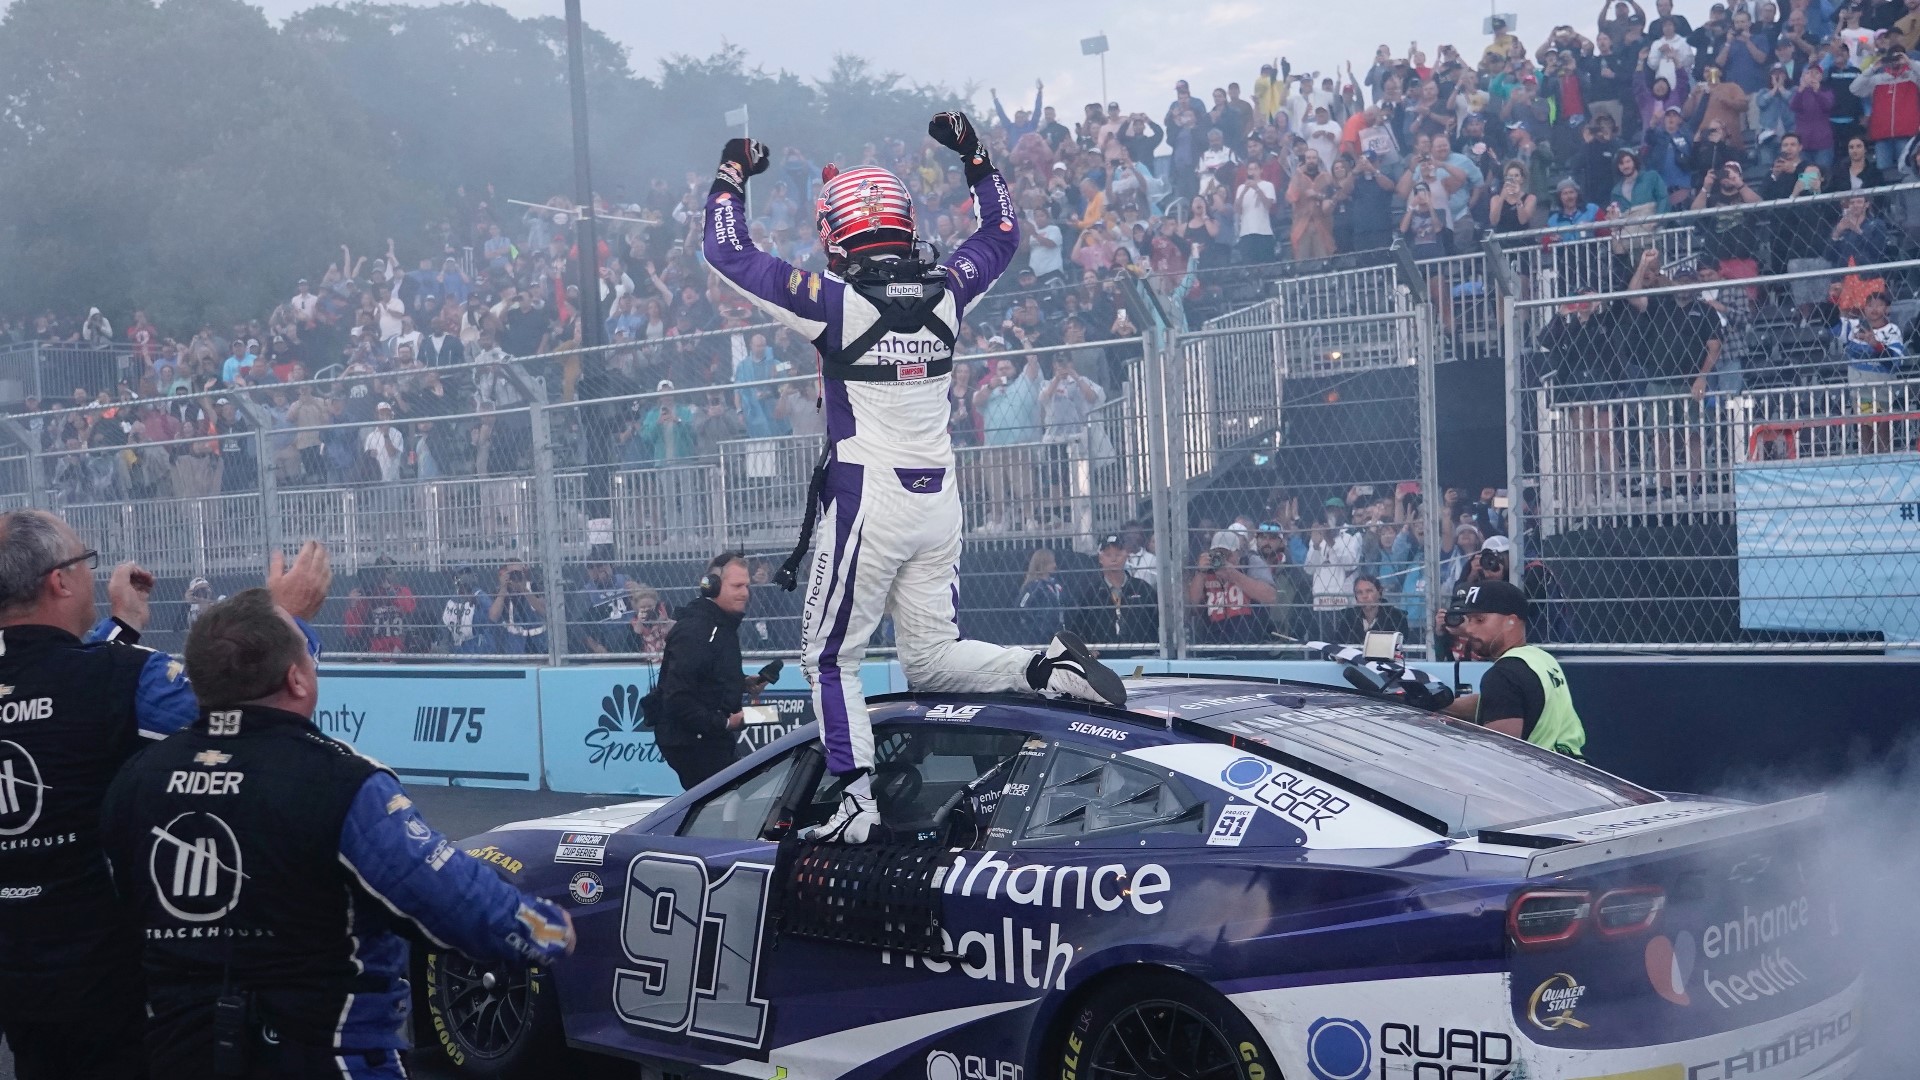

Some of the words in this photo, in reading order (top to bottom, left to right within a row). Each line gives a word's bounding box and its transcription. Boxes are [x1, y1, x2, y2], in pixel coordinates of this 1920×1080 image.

[714, 206, 727, 244] health
[725, 205, 743, 251] enhance
[890, 286, 919, 295] Hybrid
[866, 335, 950, 353] nhanc
[901, 367, 924, 376] SIMPSON
[807, 552, 829, 607] health
[1067, 721, 1129, 741] SIEMENS
[584, 728, 667, 771] Sports
[166, 770, 244, 794] RIDER
[1270, 771, 1350, 815] QUAD
[1254, 783, 1335, 832] LOCK
[575, 834, 603, 844] NASCAR
[1214, 815, 1248, 837] 91
[562, 847, 577, 857] CUP
[577, 848, 598, 858] SERIES
[0, 885, 43, 899] sparco
[944, 850, 1171, 915] nhance
[1702, 895, 1809, 959] enhance
[613, 851, 775, 1049] 91
[1541, 985, 1586, 1002] QUAKER
[1703, 947, 1808, 1009] health
[1546, 997, 1579, 1012] STATE
[1380, 1022, 1512, 1066] QUAD
